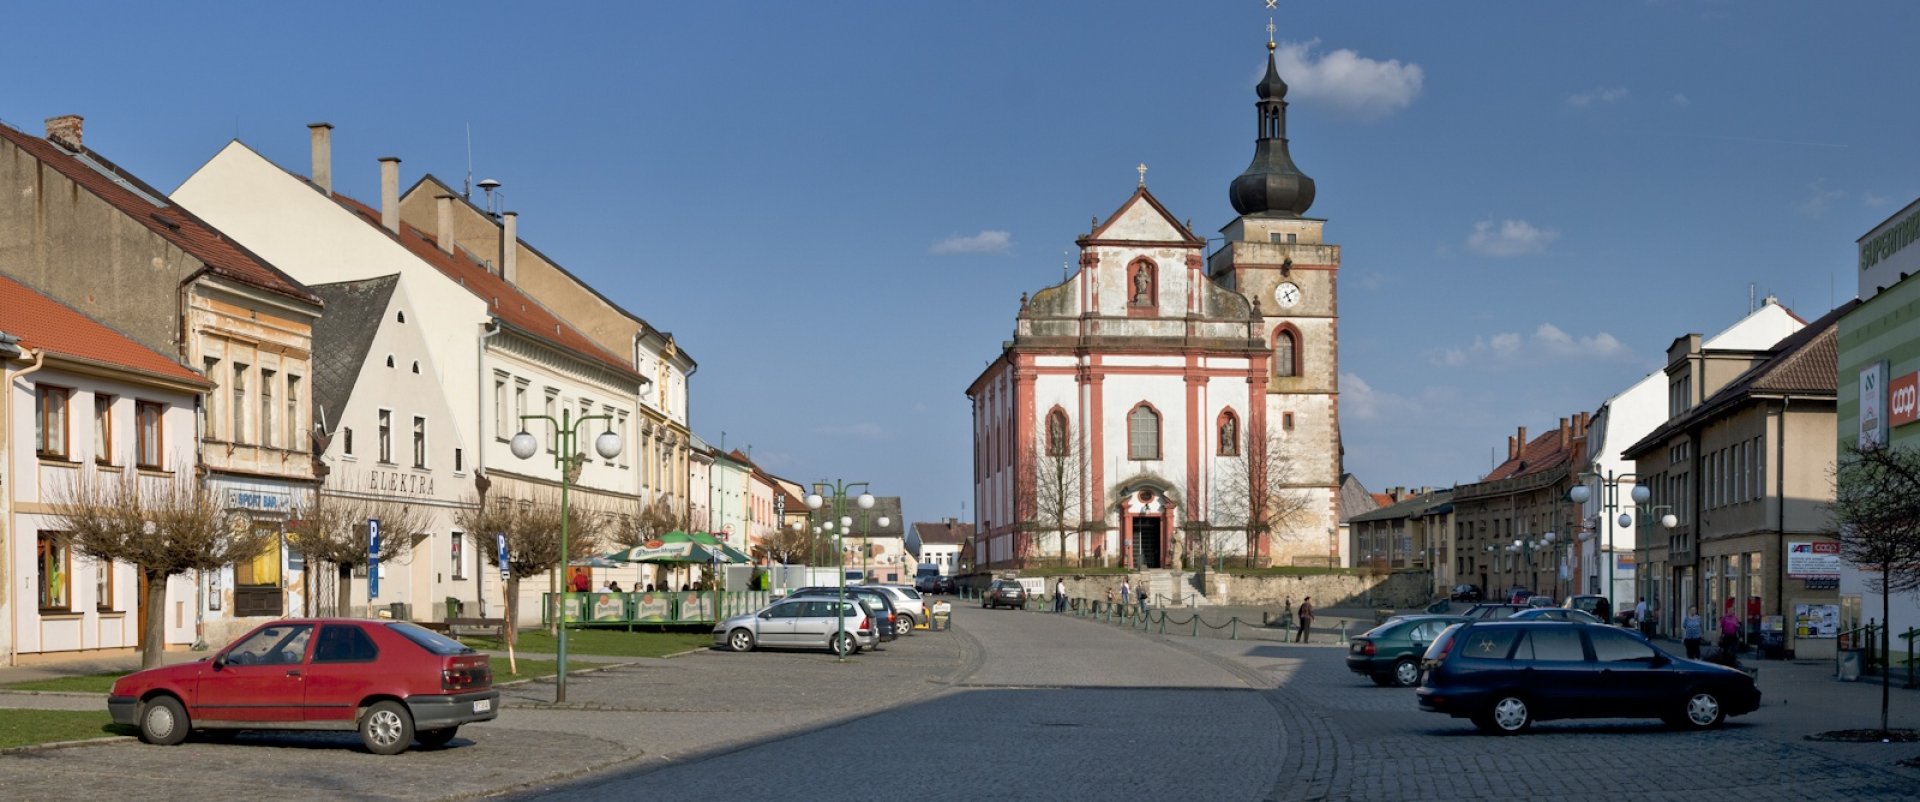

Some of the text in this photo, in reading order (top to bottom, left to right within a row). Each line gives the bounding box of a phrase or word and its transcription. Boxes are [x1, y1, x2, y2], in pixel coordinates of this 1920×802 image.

[1892, 384, 1916, 417] coop
[370, 470, 434, 495] ELEKTRA
[777, 494, 785, 529] HOTEL
[370, 521, 378, 546] P
[498, 534, 505, 555] P
